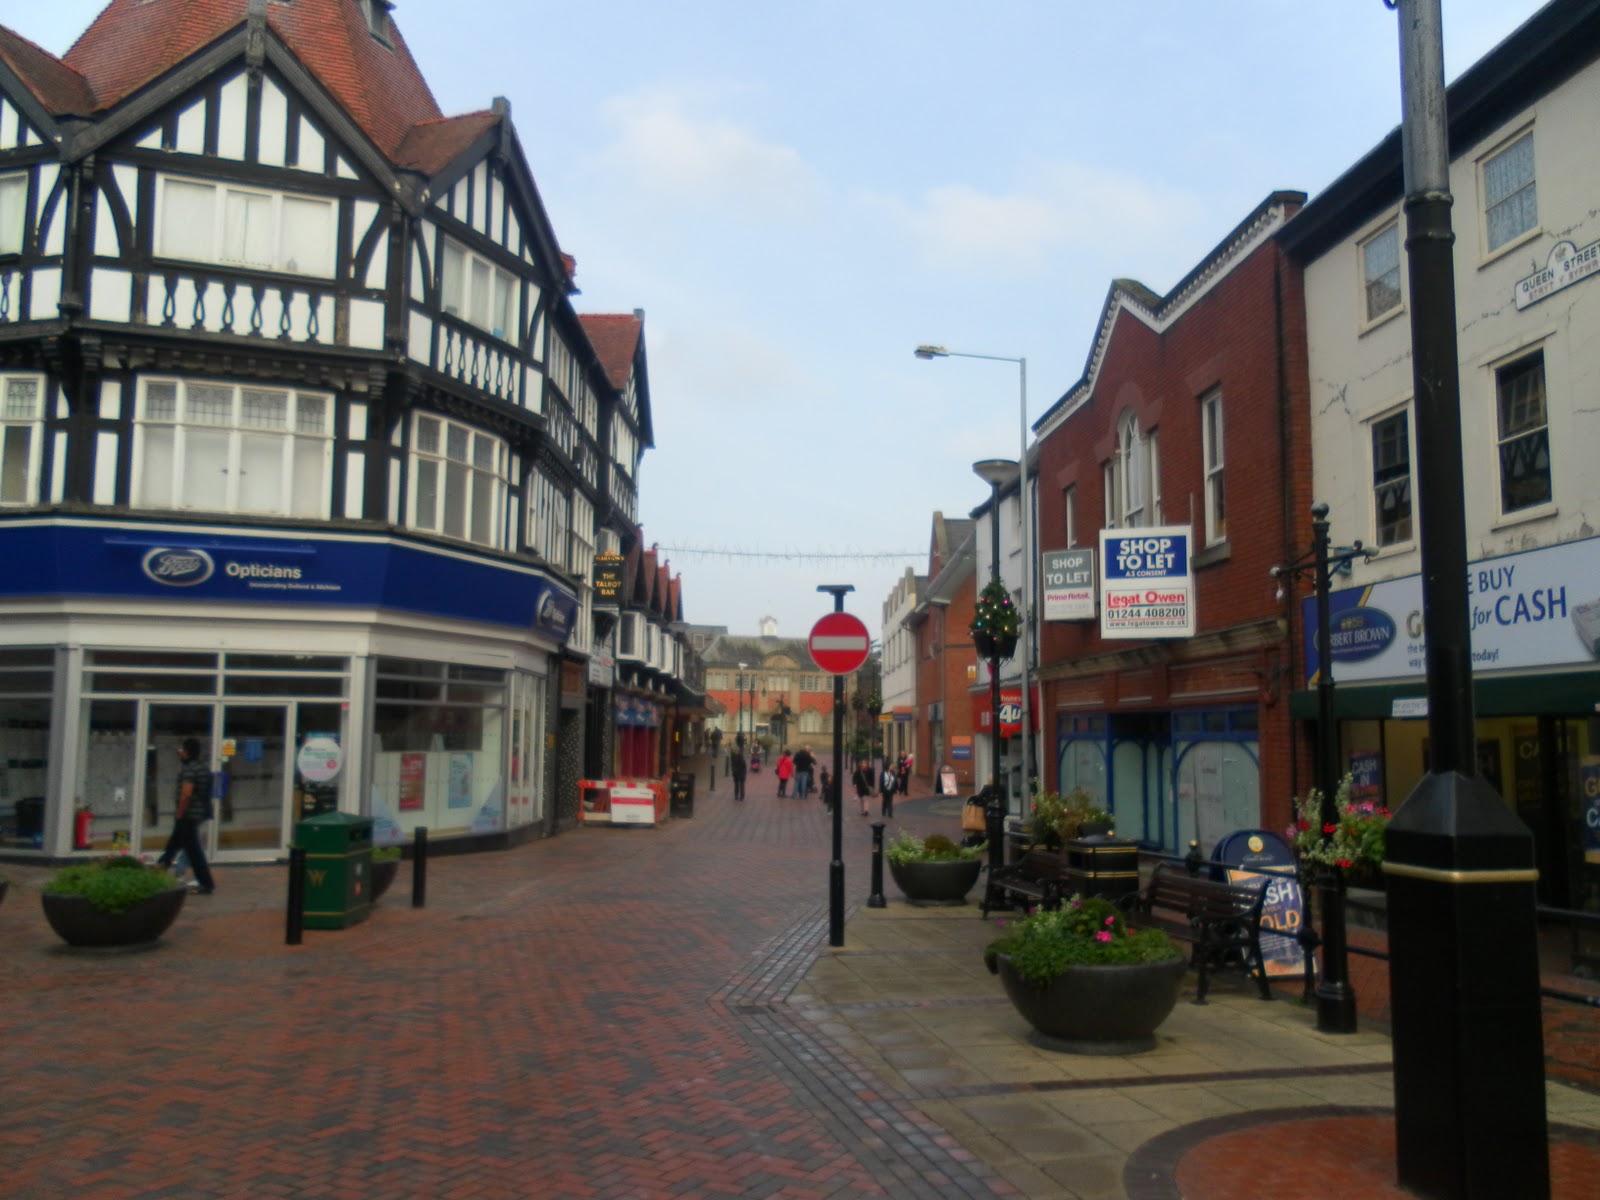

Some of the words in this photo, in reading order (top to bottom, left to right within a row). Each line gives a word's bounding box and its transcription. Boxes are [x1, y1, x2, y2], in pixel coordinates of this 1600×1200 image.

[1522, 269, 1554, 292] QUEEN
[1119, 539, 1171, 555] SHOP
[1052, 557, 1083, 569] SHOP
[1117, 556, 1142, 570] TO
[1146, 554, 1175, 569] LET
[225, 563, 302, 579] Opticians
[1046, 574, 1063, 585] TO
[1066, 571, 1089, 584] LET
[1478, 565, 1515, 593] BUY
[1047, 594, 1067, 602] Prime
[1107, 592, 1140, 608] Legat
[1145, 591, 1185, 604] Owen
[1108, 608, 1141, 619] 01244
[1144, 608, 1186, 618] 408200
[1472, 605, 1492, 630] for
[1495, 585, 1567, 626] CASH
[1354, 627, 1390, 643] BROWN
[1352, 758, 1377, 774] CASH
[1360, 772, 1370, 786] IN
